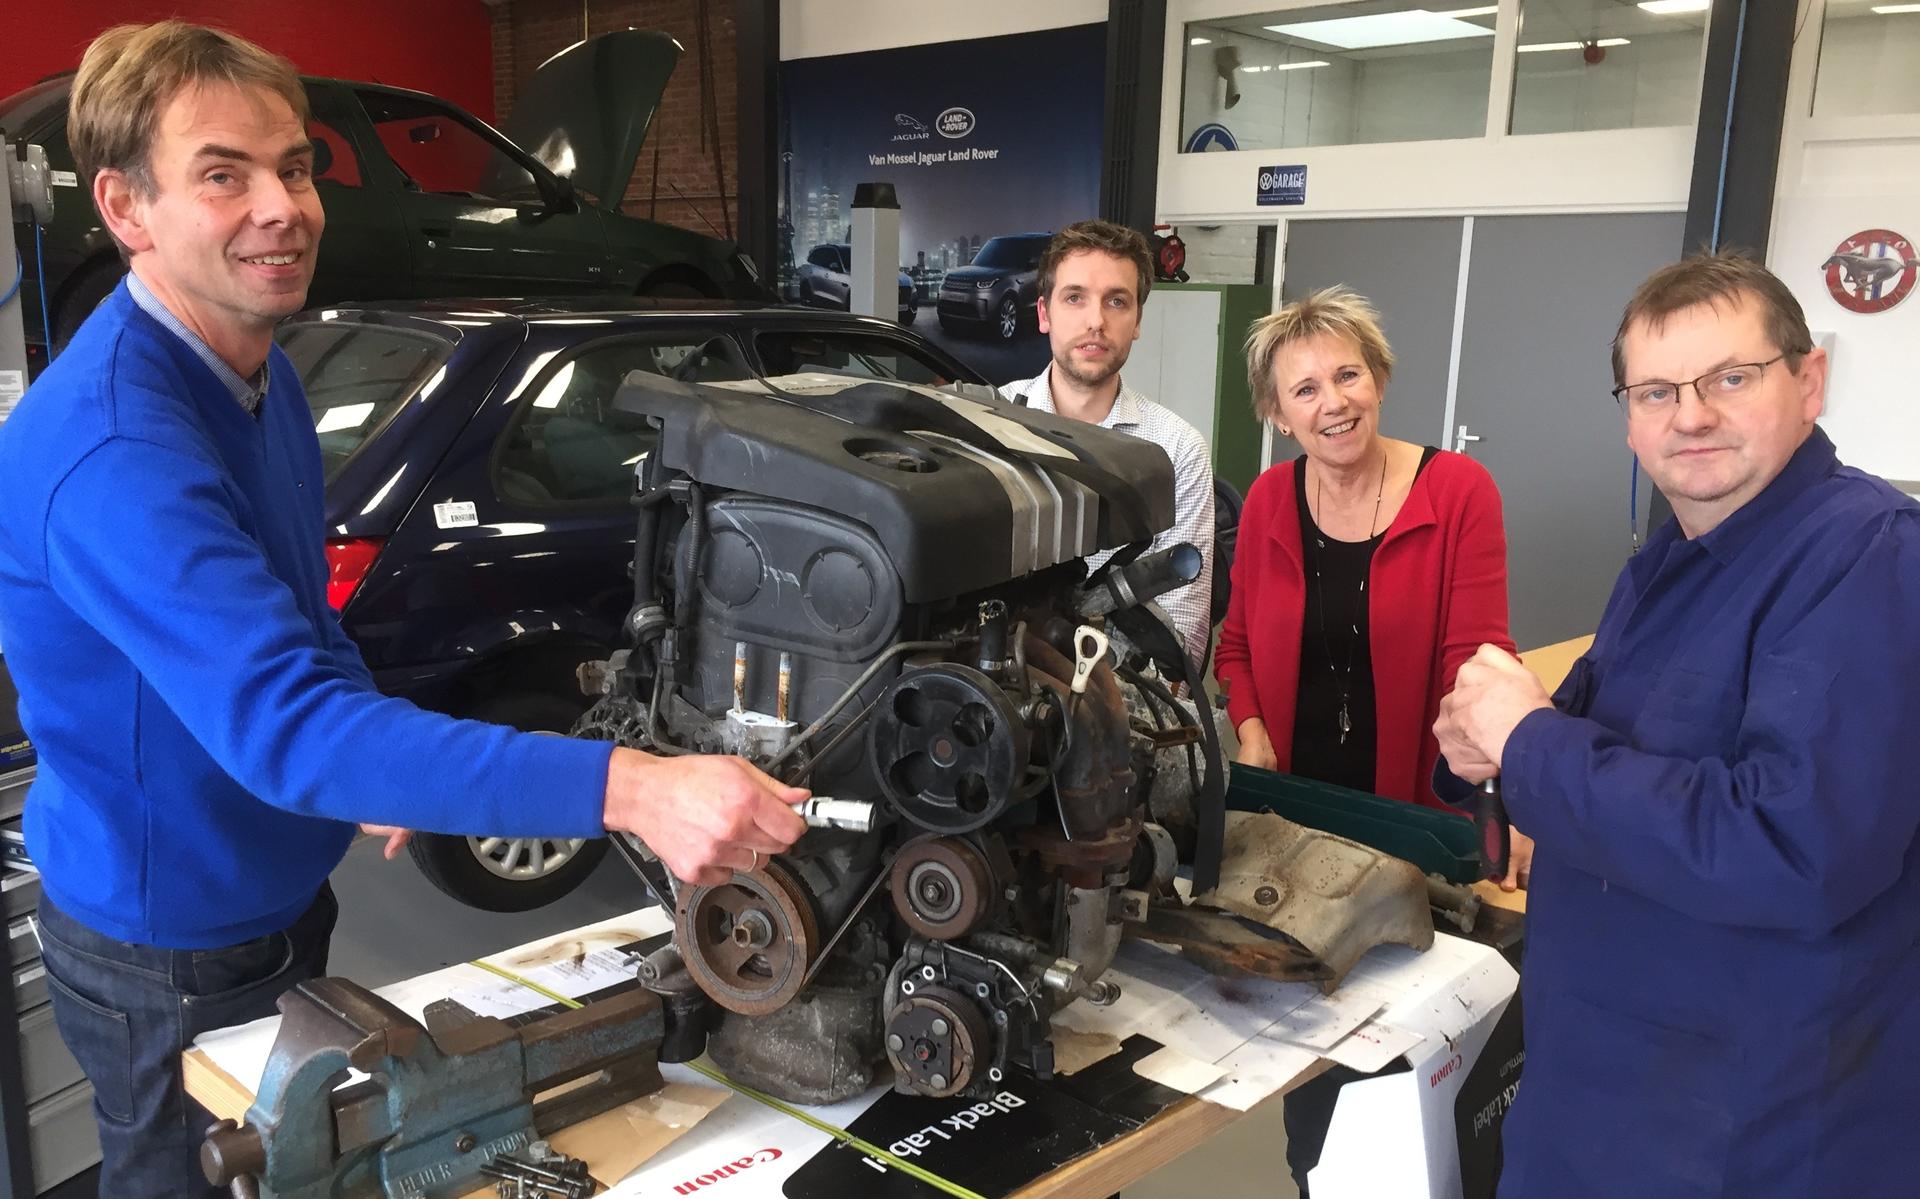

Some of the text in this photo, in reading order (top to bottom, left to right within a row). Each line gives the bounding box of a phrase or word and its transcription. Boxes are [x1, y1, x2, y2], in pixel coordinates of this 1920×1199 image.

[944, 114, 963, 123] LAND
[945, 122, 968, 131] ROVER
[891, 132, 929, 141] JAGUAR
[869, 147, 999, 166] Van Mossel Jaguar Land Rover
[1273, 172, 1304, 188] GARAGE
[1430, 1054, 1463, 1088] Canon
[1500, 1050, 1526, 1078] remium
[941, 1090, 1026, 1132] Black
[1473, 1095, 1503, 1139] Label
[673, 1147, 783, 1196] Canon
